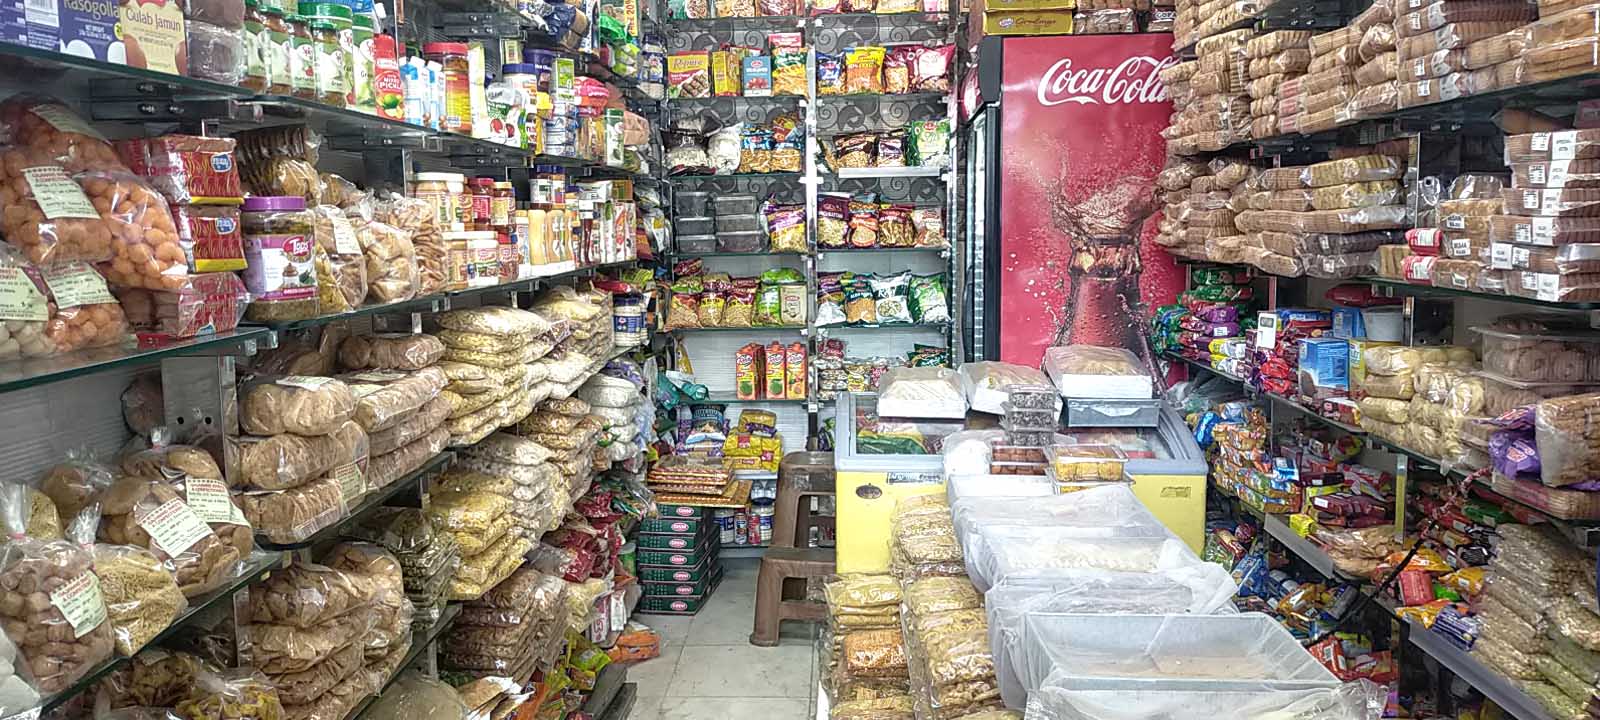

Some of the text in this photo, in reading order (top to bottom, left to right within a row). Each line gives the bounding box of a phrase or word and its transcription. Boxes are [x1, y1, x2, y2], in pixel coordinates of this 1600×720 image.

[126, 8, 181, 32] Gulab Jamun
[1155, 10, 1176, 20] GOPA
